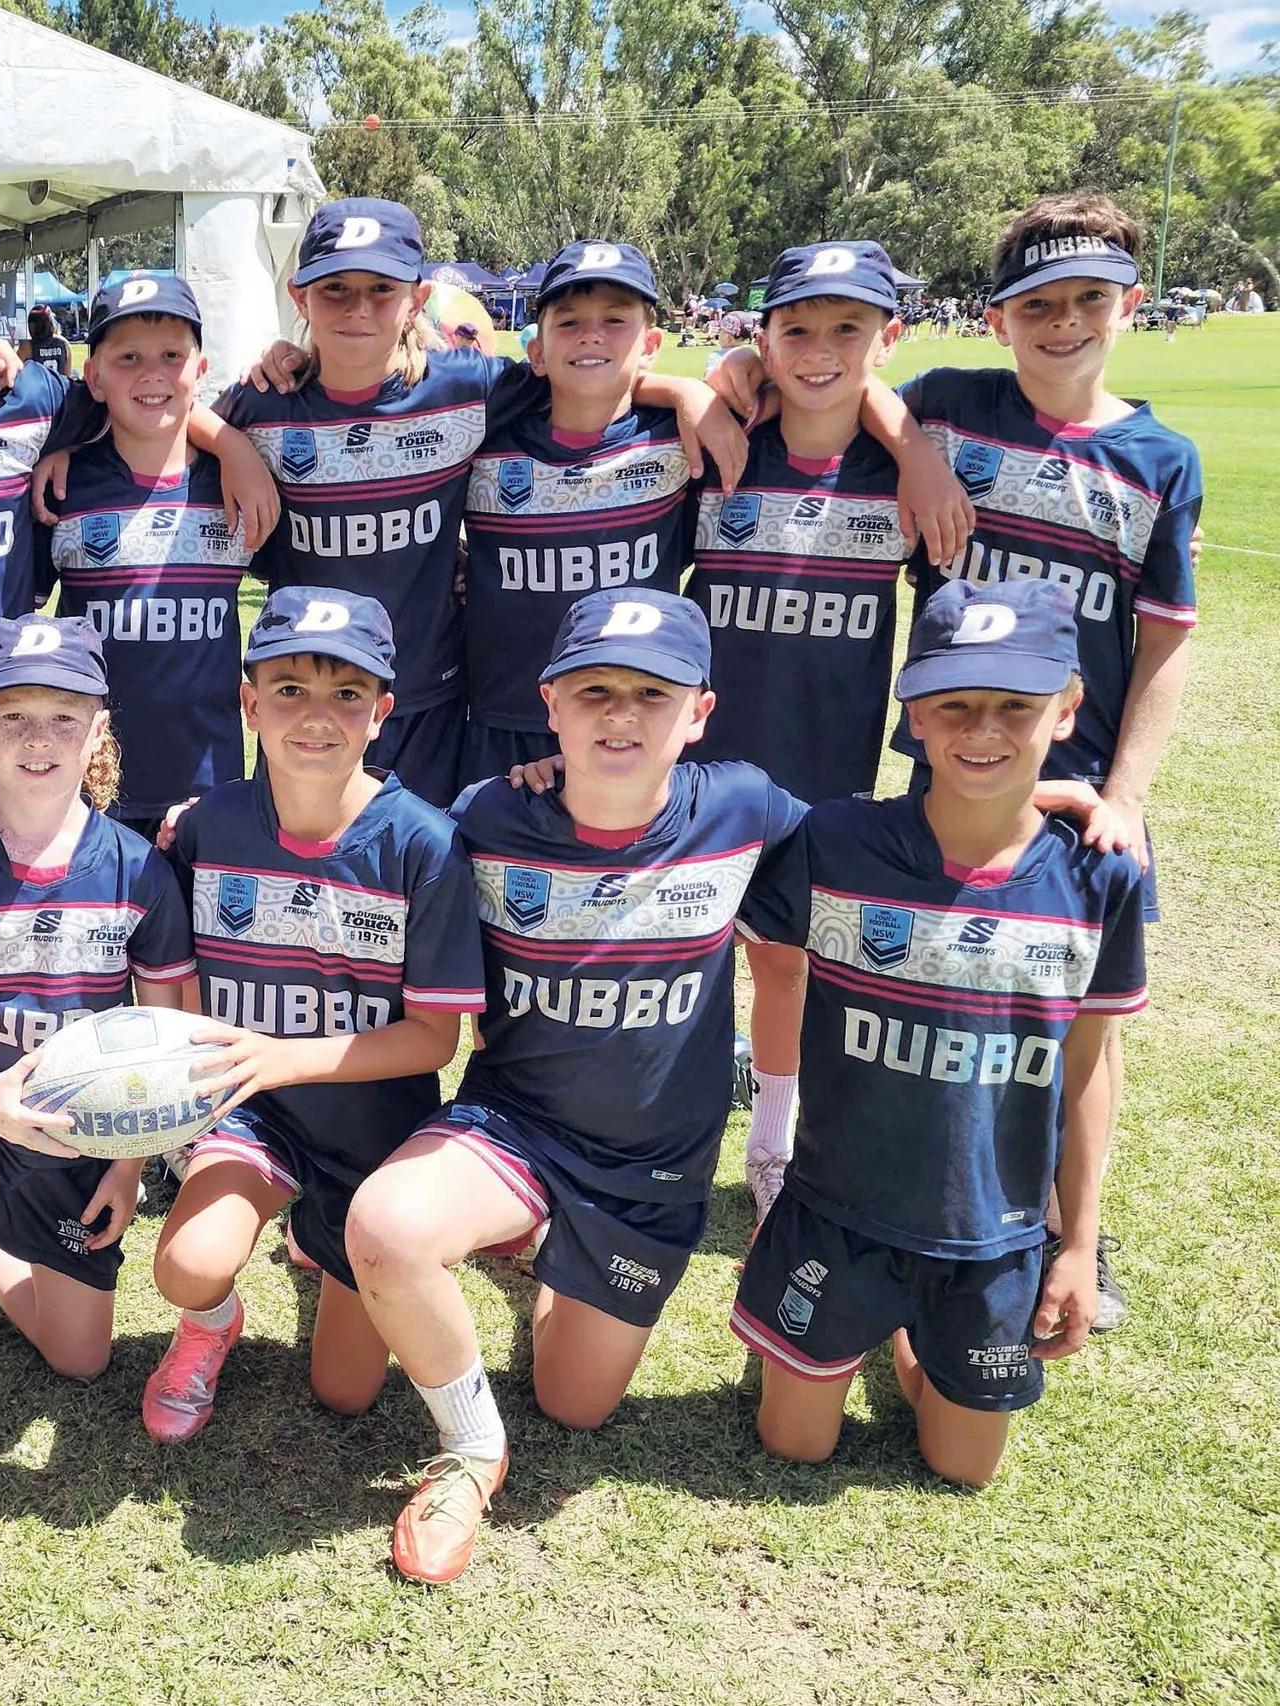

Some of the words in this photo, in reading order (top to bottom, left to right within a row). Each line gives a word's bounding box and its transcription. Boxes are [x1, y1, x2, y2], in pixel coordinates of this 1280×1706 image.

[335, 217, 380, 249] D
[577, 245, 621, 272] D
[1024, 235, 1109, 267] DUBBO
[805, 248, 857, 277] D
[118, 279, 159, 307] D
[395, 432, 444, 447] Touch
[407, 429, 436, 438] DUBBO
[341, 445, 375, 455] STRUDDYS
[412, 447, 437, 460] 1975
[615, 463, 665, 479] Touch
[630, 477, 657, 490] 1975
[1026, 478, 1066, 493] STRUDDYS
[288, 500, 442, 557] DUBBO
[785, 518, 824, 527] STRUDDYS
[846, 516, 893, 530] Touch
[199, 524, 234, 538] Touc
[860, 532, 884, 544] 1975
[212, 539, 229, 551] 1975
[499, 533, 658, 592] DUBBO
[87, 598, 228, 641] DUBBO
[295, 601, 350, 632] D
[601, 601, 663, 639] D
[709, 585, 879, 639] DUBBO
[950, 604, 1017, 645] D
[10, 624, 62, 656] D
[656, 884, 717, 903] Touch
[673, 881, 710, 891] DUBBO
[514, 889, 535, 900] NSW
[581, 897, 628, 908] STRUDDYS
[357, 910, 391, 921] DUBBO
[676, 904, 709, 919] 1975
[341, 911, 399, 933] Touch
[25, 935, 63, 943] STRUDDYS
[358, 931, 388, 946] 1975
[872, 927, 896, 939] NSW
[102, 945, 128, 956] 1975
[947, 943, 996, 956] STRUDDYS
[1024, 944, 1076, 962] Touch
[1039, 965, 1063, 977] 1975
[209, 976, 391, 1036] DUBBO
[503, 966, 703, 1031] DUBBO
[844, 1006, 1060, 1088] DUBBO
[67, 1095, 213, 1137] STEEDEN
[58, 1220, 93, 1240] Touc
[610, 1254, 662, 1286] Touch
[617, 1275, 646, 1293] 1975
[986, 1343, 1028, 1354] DUBBO
[991, 1364, 1028, 1381] 1975
